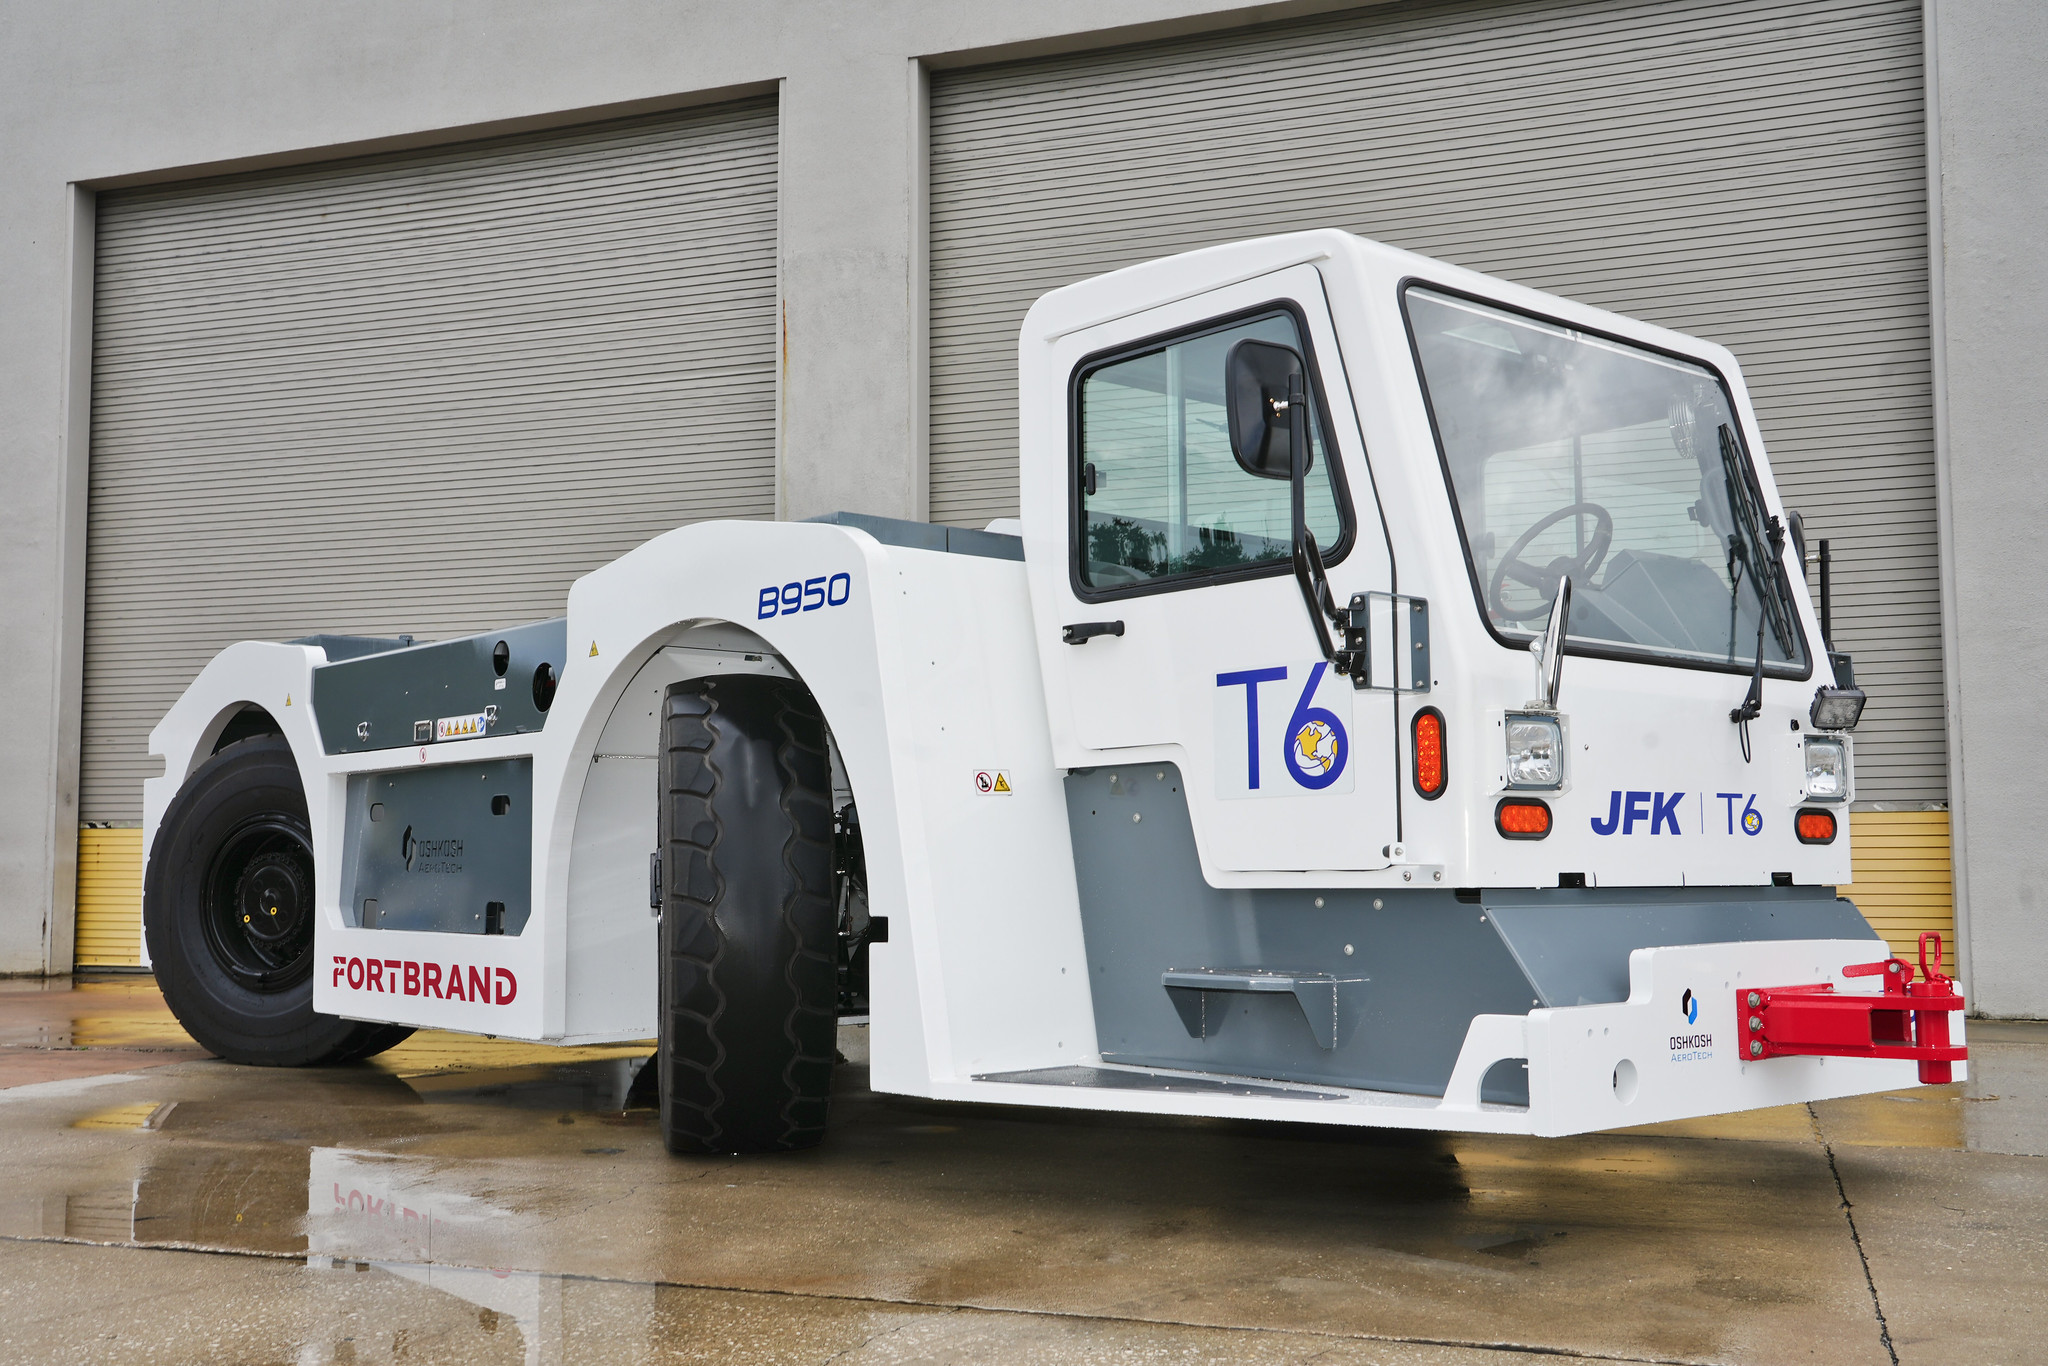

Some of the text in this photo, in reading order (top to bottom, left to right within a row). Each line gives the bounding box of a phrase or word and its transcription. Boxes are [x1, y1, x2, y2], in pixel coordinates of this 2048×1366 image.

[758, 572, 851, 620] B950
[1216, 661, 1349, 790] T6
[1590, 791, 1763, 836] JFK T6
[419, 840, 463, 857] OSHKOSH
[333, 956, 517, 1006] FORTBRAND
[1669, 1034, 1713, 1050] OSHKOSH
